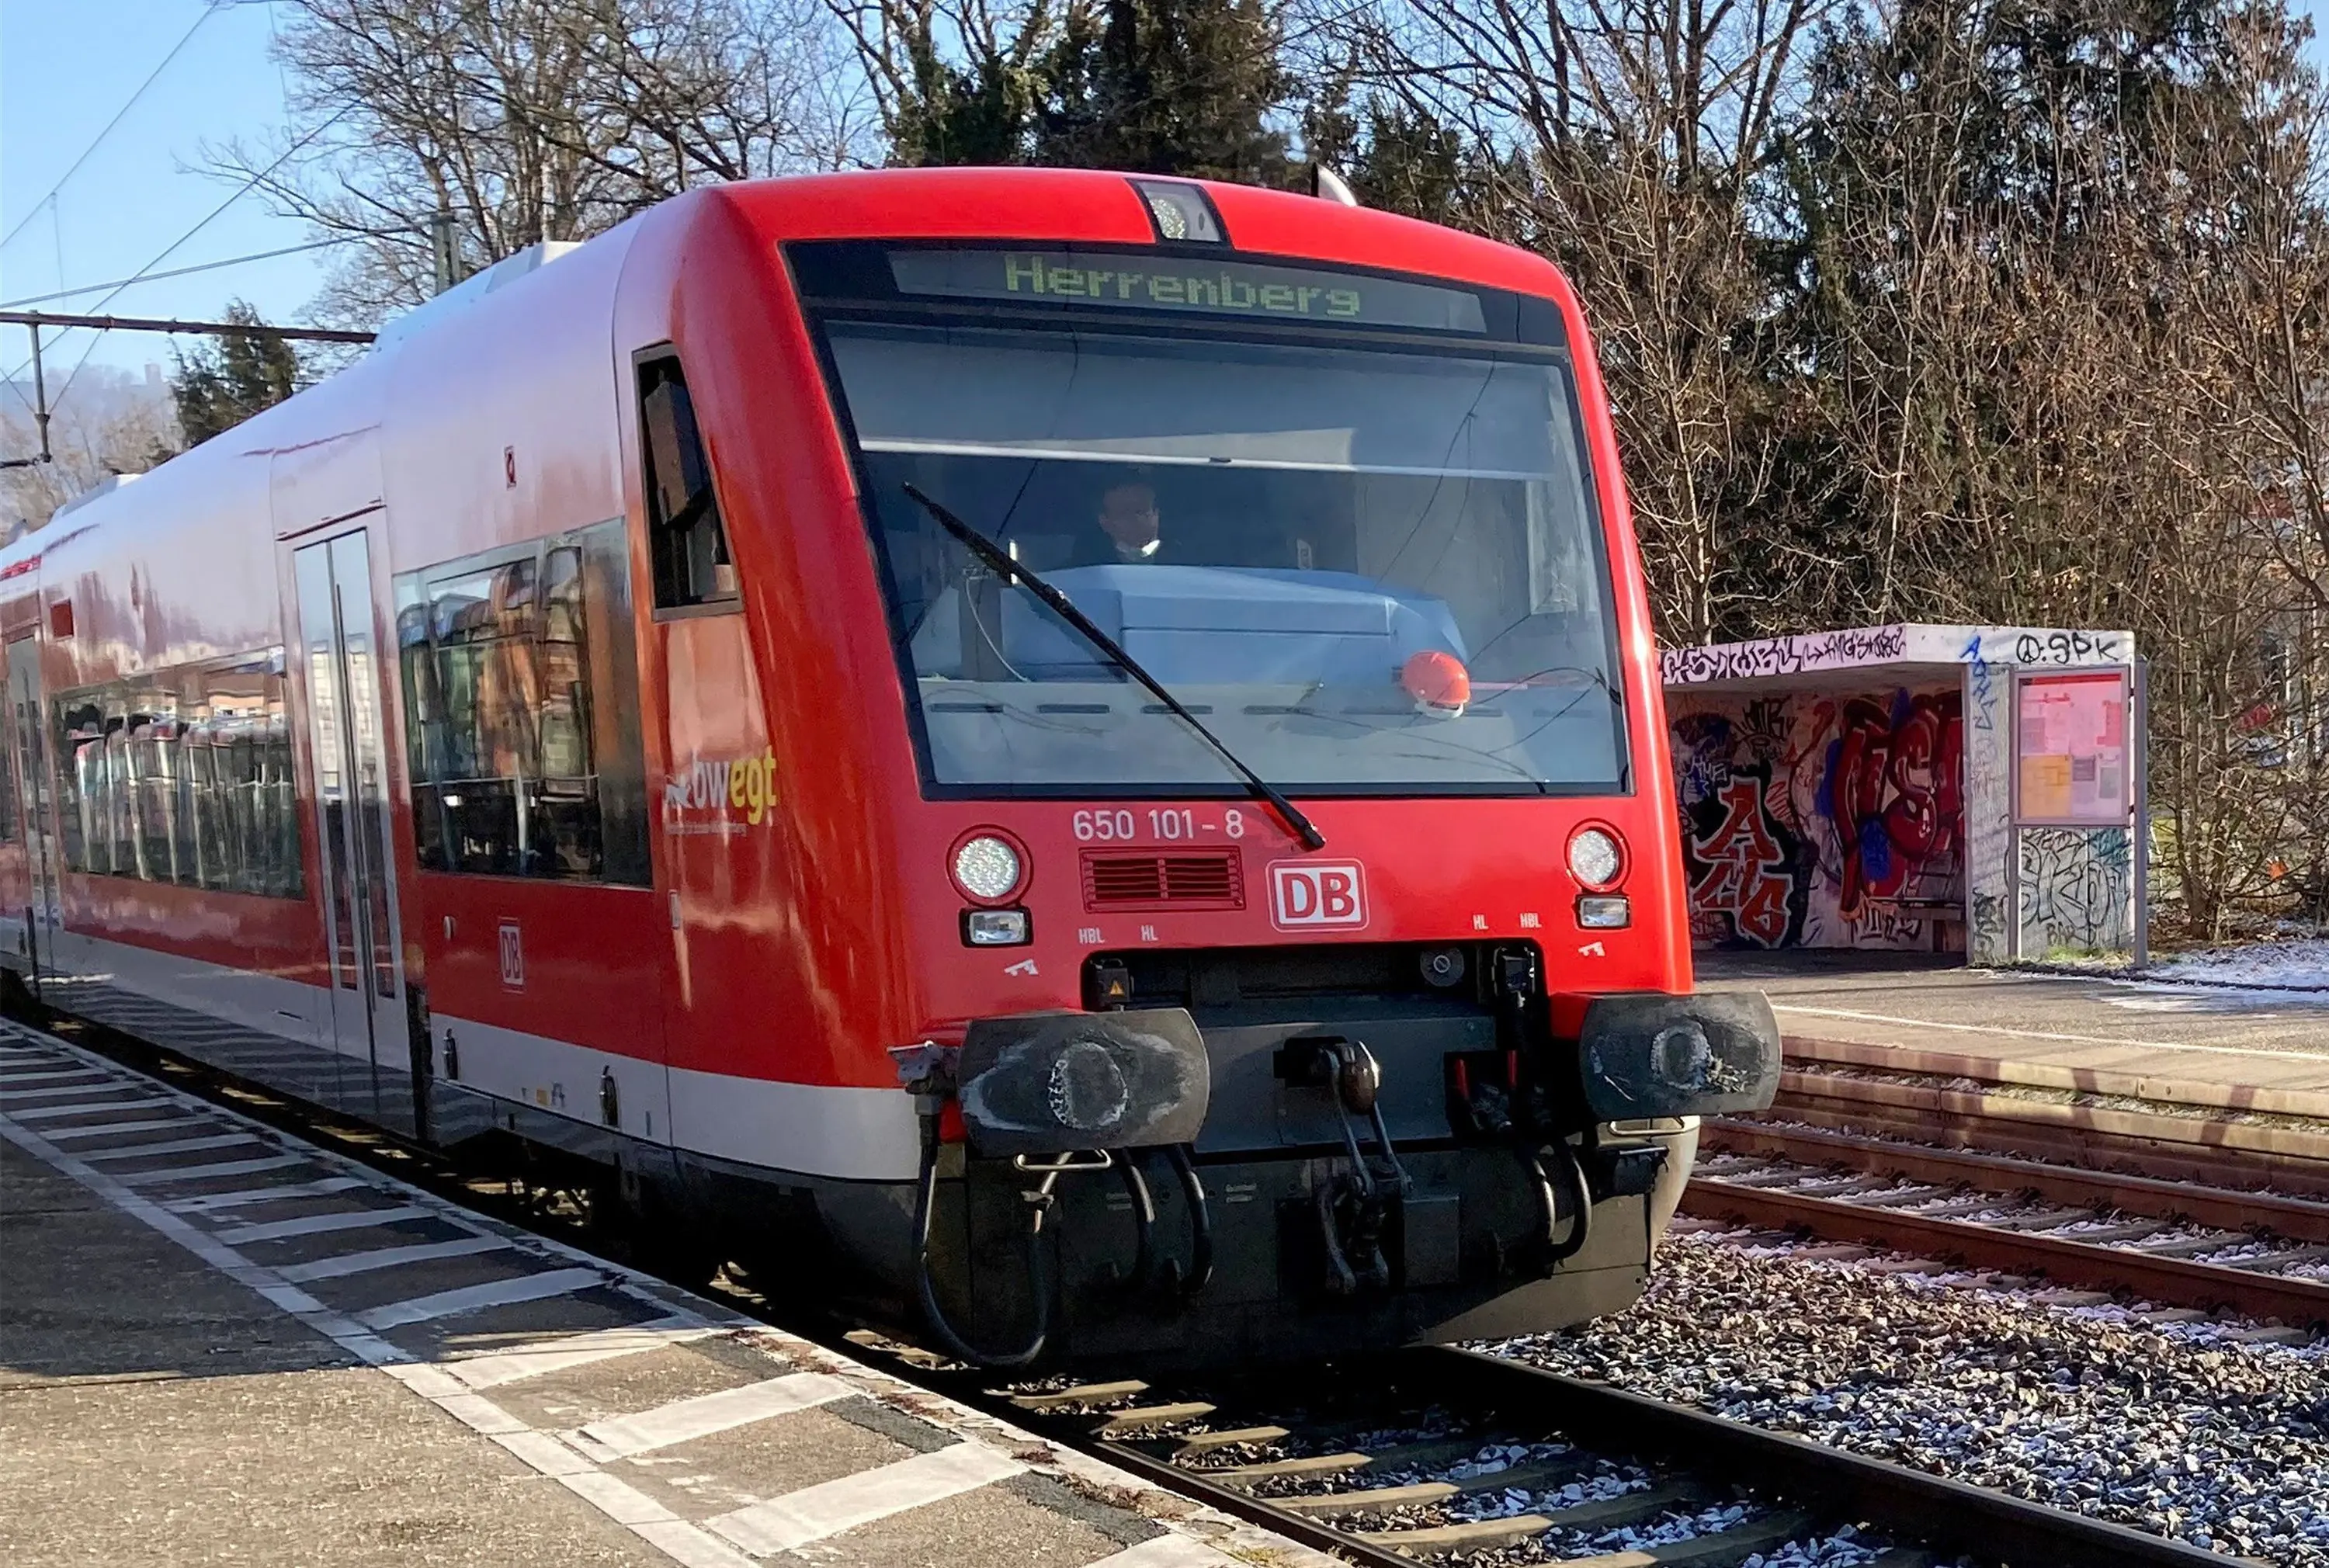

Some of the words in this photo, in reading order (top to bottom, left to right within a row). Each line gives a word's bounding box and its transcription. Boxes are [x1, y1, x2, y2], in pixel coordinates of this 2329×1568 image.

[1004, 255, 1361, 317] Herrenberg
[1072, 809, 1135, 841] 650
[1278, 869, 1359, 922] DB
[1472, 914, 1489, 931] HL
[1519, 912, 1543, 928] HBL
[1078, 928, 1105, 944] HBL
[1140, 924, 1158, 941] HL
[500, 928, 522, 981] DB
